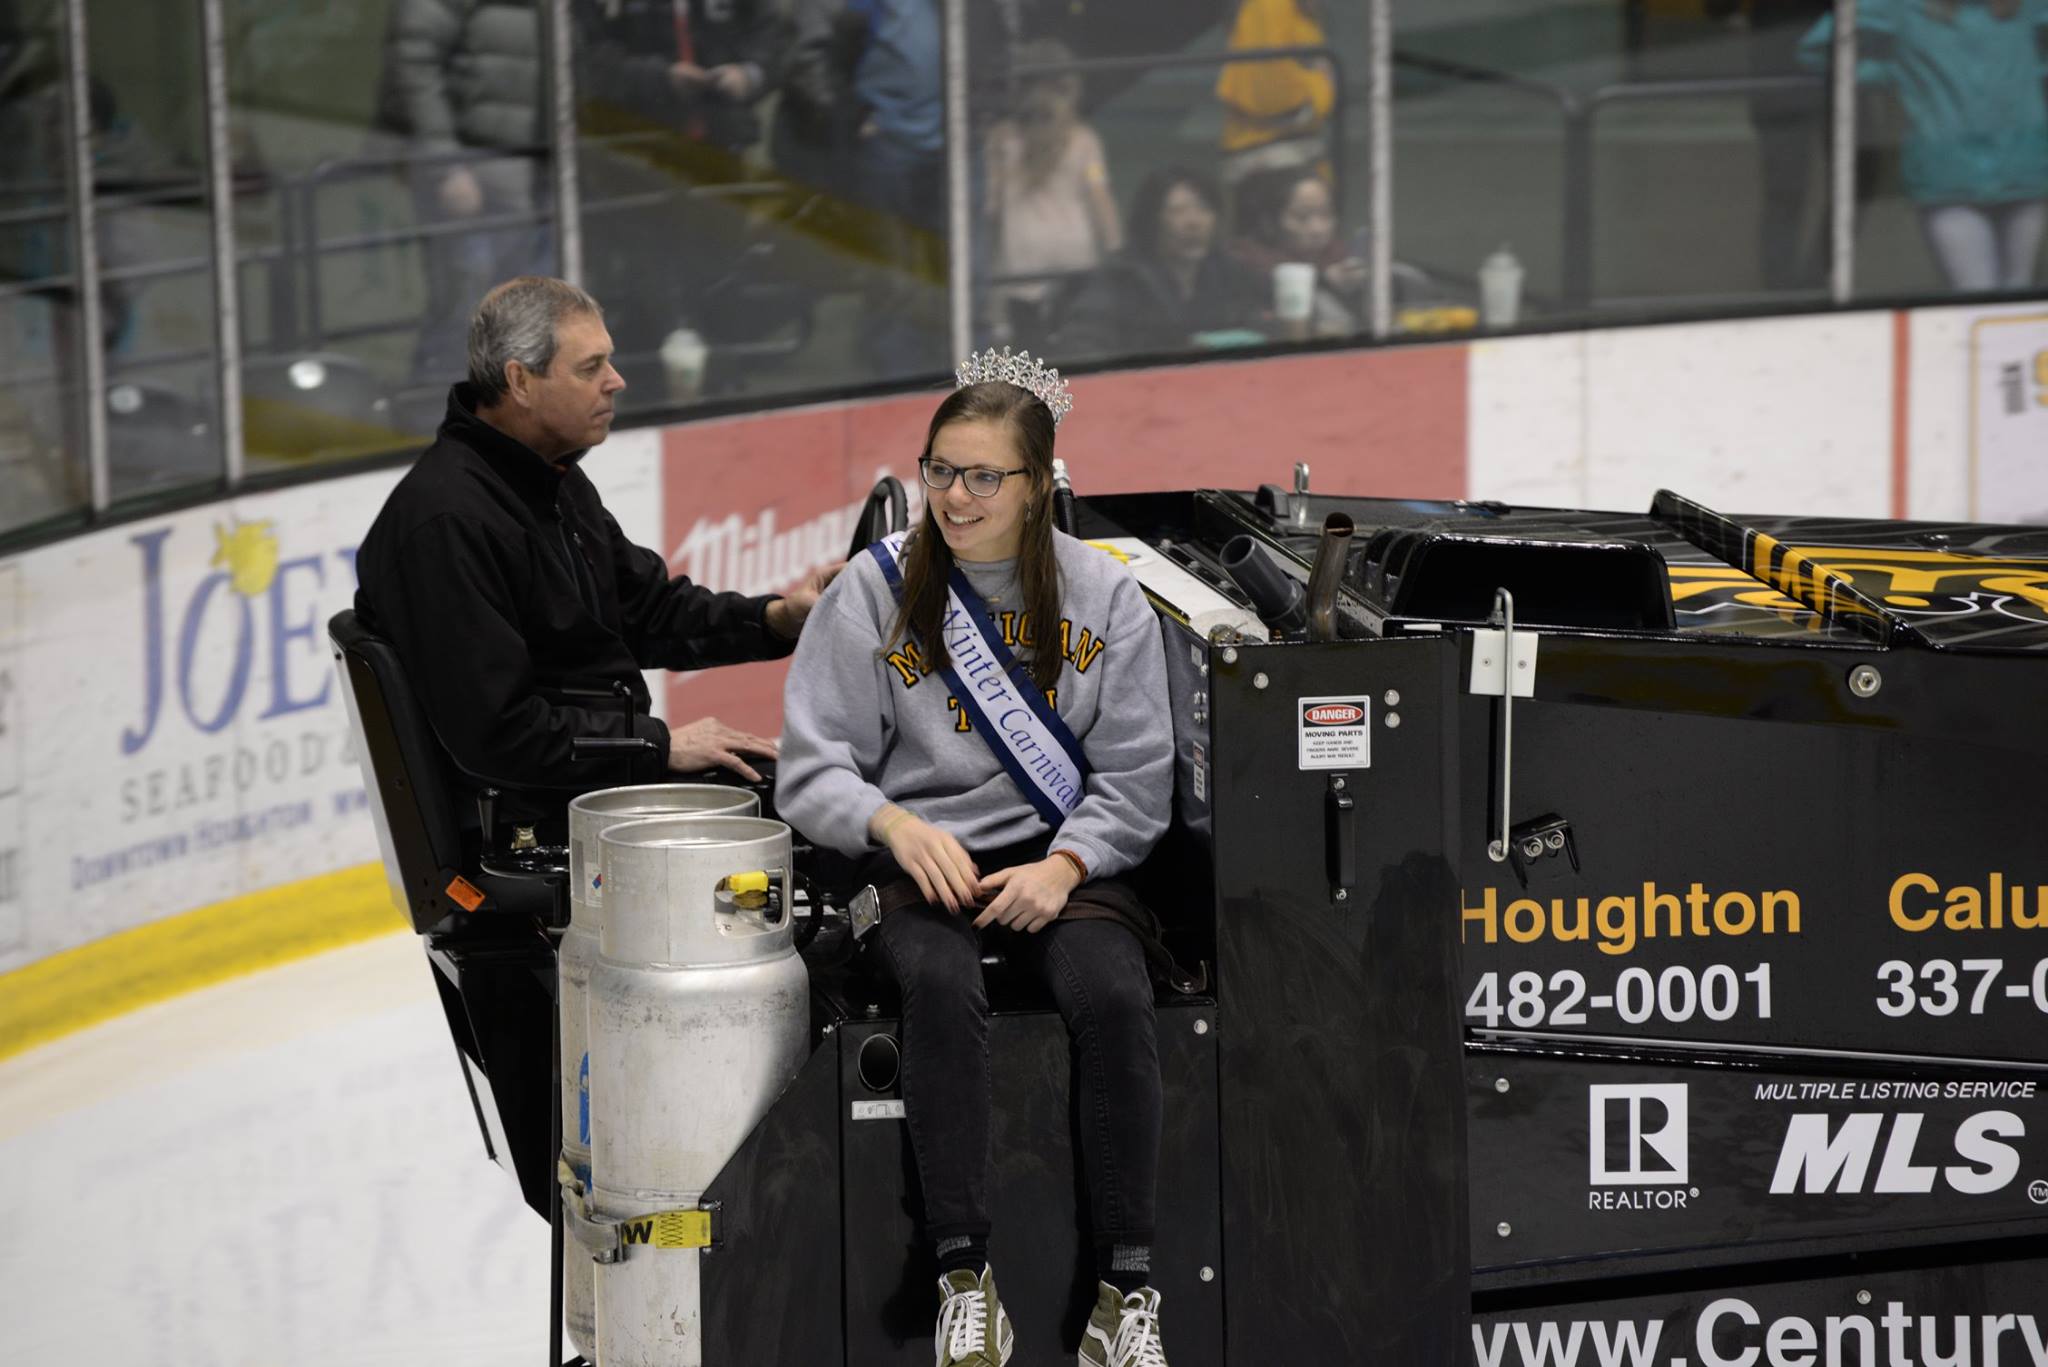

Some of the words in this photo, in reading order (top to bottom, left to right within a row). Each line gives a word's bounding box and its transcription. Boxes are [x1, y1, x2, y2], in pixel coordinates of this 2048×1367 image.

[1311, 708, 1356, 721] DANGER
[121, 731, 323, 824] SEAFOOD
[1000, 708, 1082, 809] Carnival
[1462, 881, 1801, 956] Houghton
[1889, 872, 2048, 932] Calu
[1465, 962, 1773, 1028] 482-0001
[1755, 1082, 1856, 1100] MULTIPLE
[1859, 1082, 1939, 1100] LISTING
[1943, 1081, 2037, 1099] SERVICE
[1769, 1110, 2026, 1195] MLS
